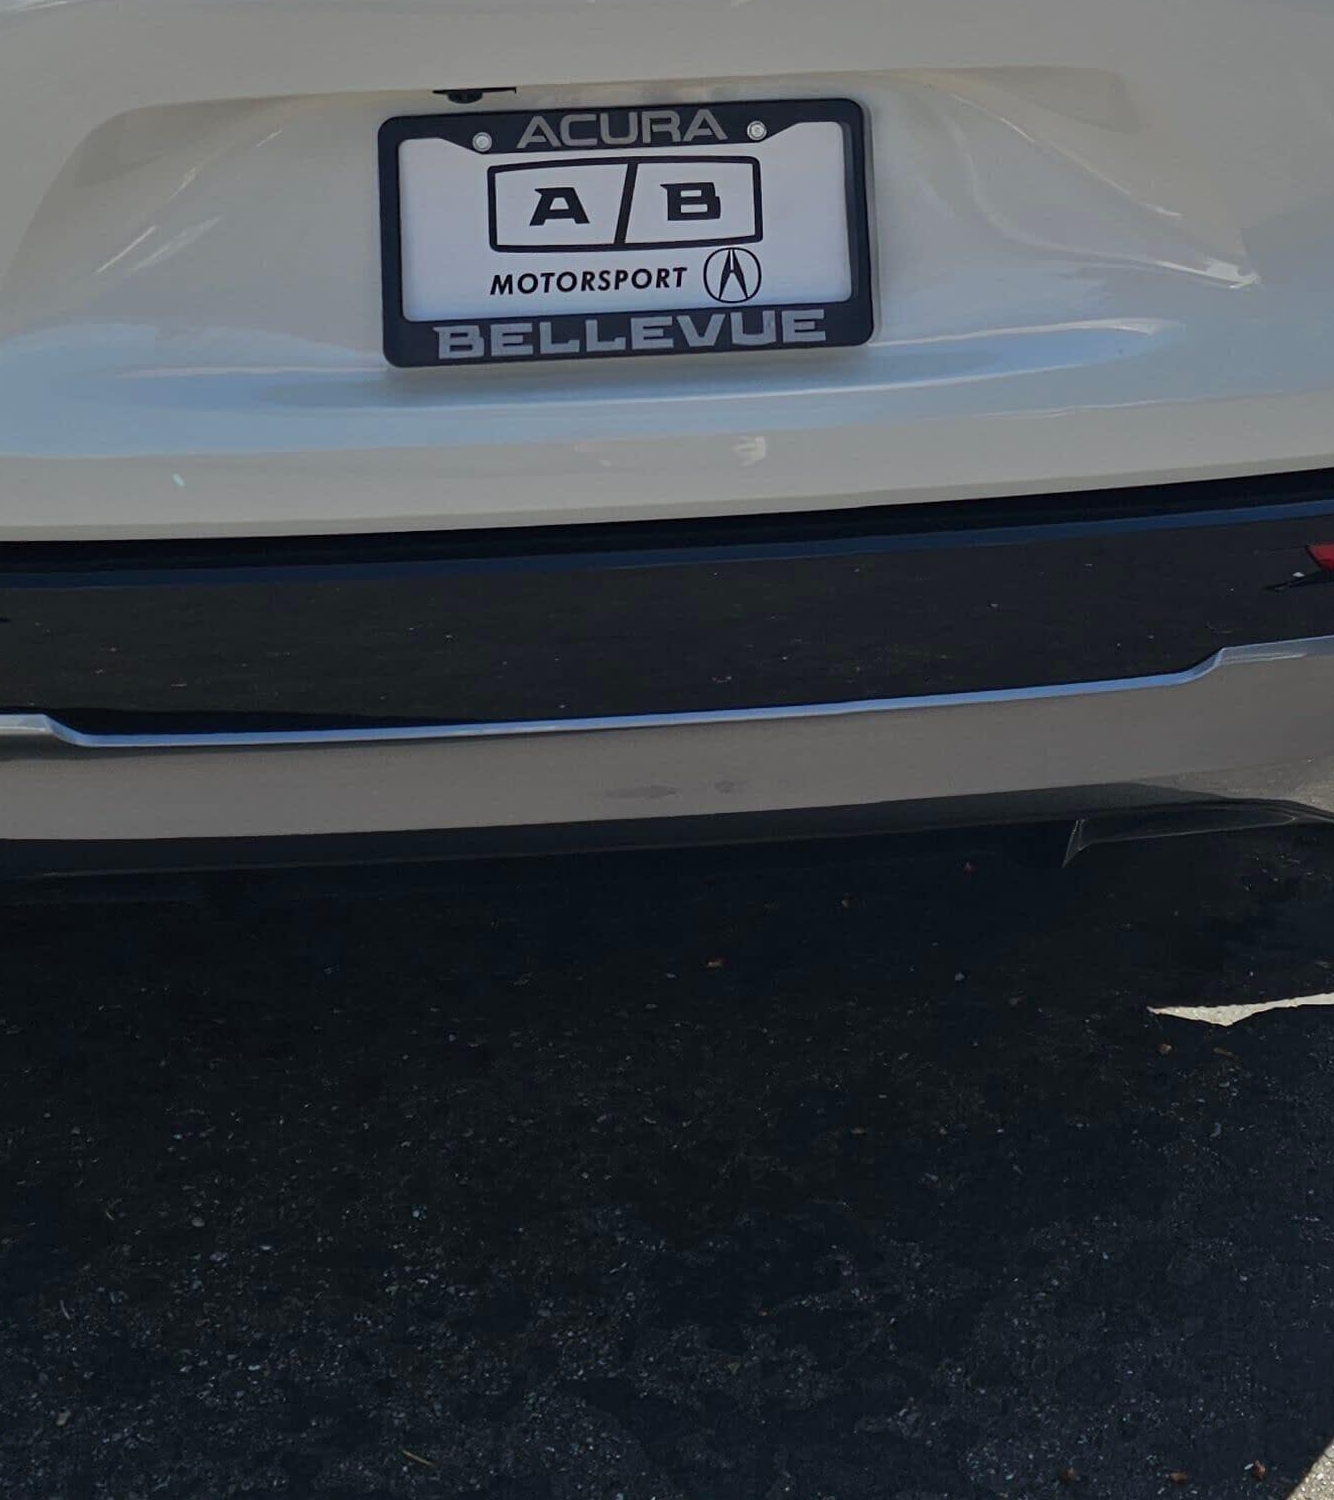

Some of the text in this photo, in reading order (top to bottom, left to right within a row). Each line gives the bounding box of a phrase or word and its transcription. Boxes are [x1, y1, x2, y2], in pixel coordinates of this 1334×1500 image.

[516, 108, 728, 149] ACURA
[490, 267, 688, 296] MOTORSPORT
[433, 309, 826, 360] BELLEVUE
